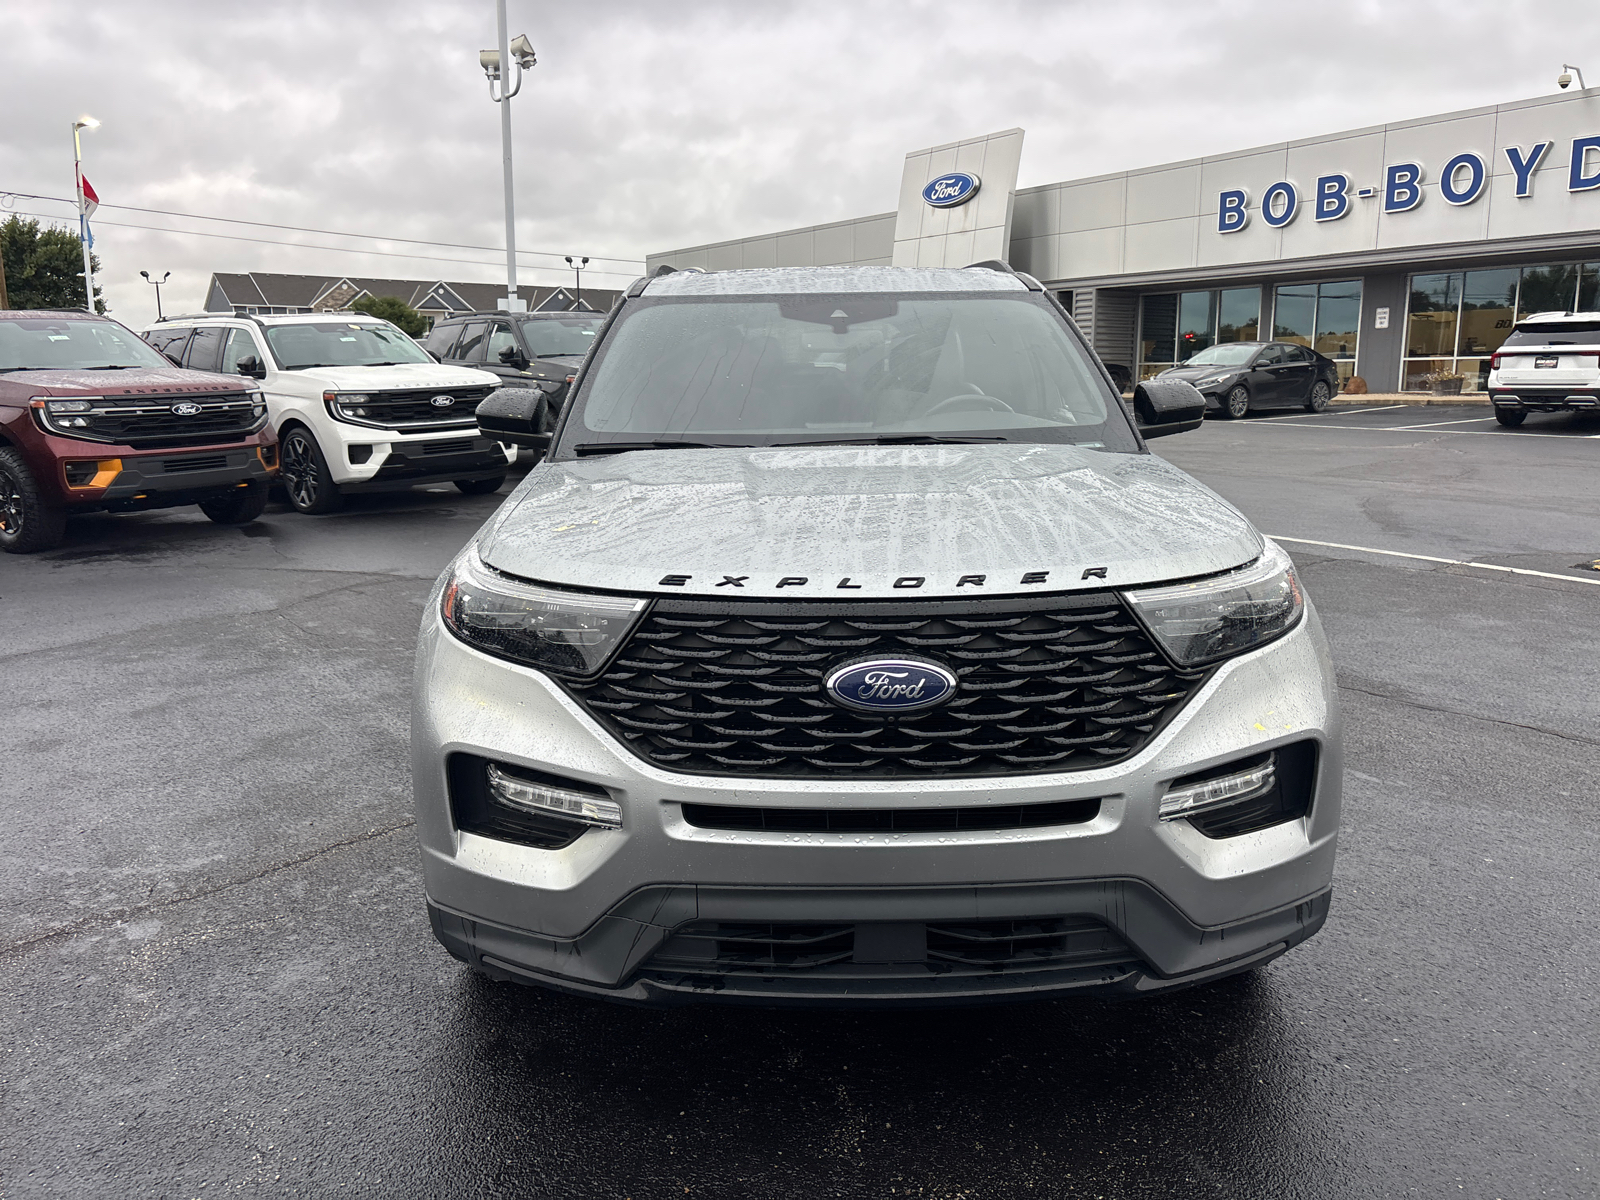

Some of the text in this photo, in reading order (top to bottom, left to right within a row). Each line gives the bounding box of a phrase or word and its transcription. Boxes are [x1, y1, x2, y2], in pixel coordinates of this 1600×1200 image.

[931, 178, 963, 200] Ford
[122, 386, 230, 394] EXPEDITION
[177, 404, 197, 414] Ford
[658, 566, 1108, 589] EXPLORER
[858, 671, 926, 699] Ford
